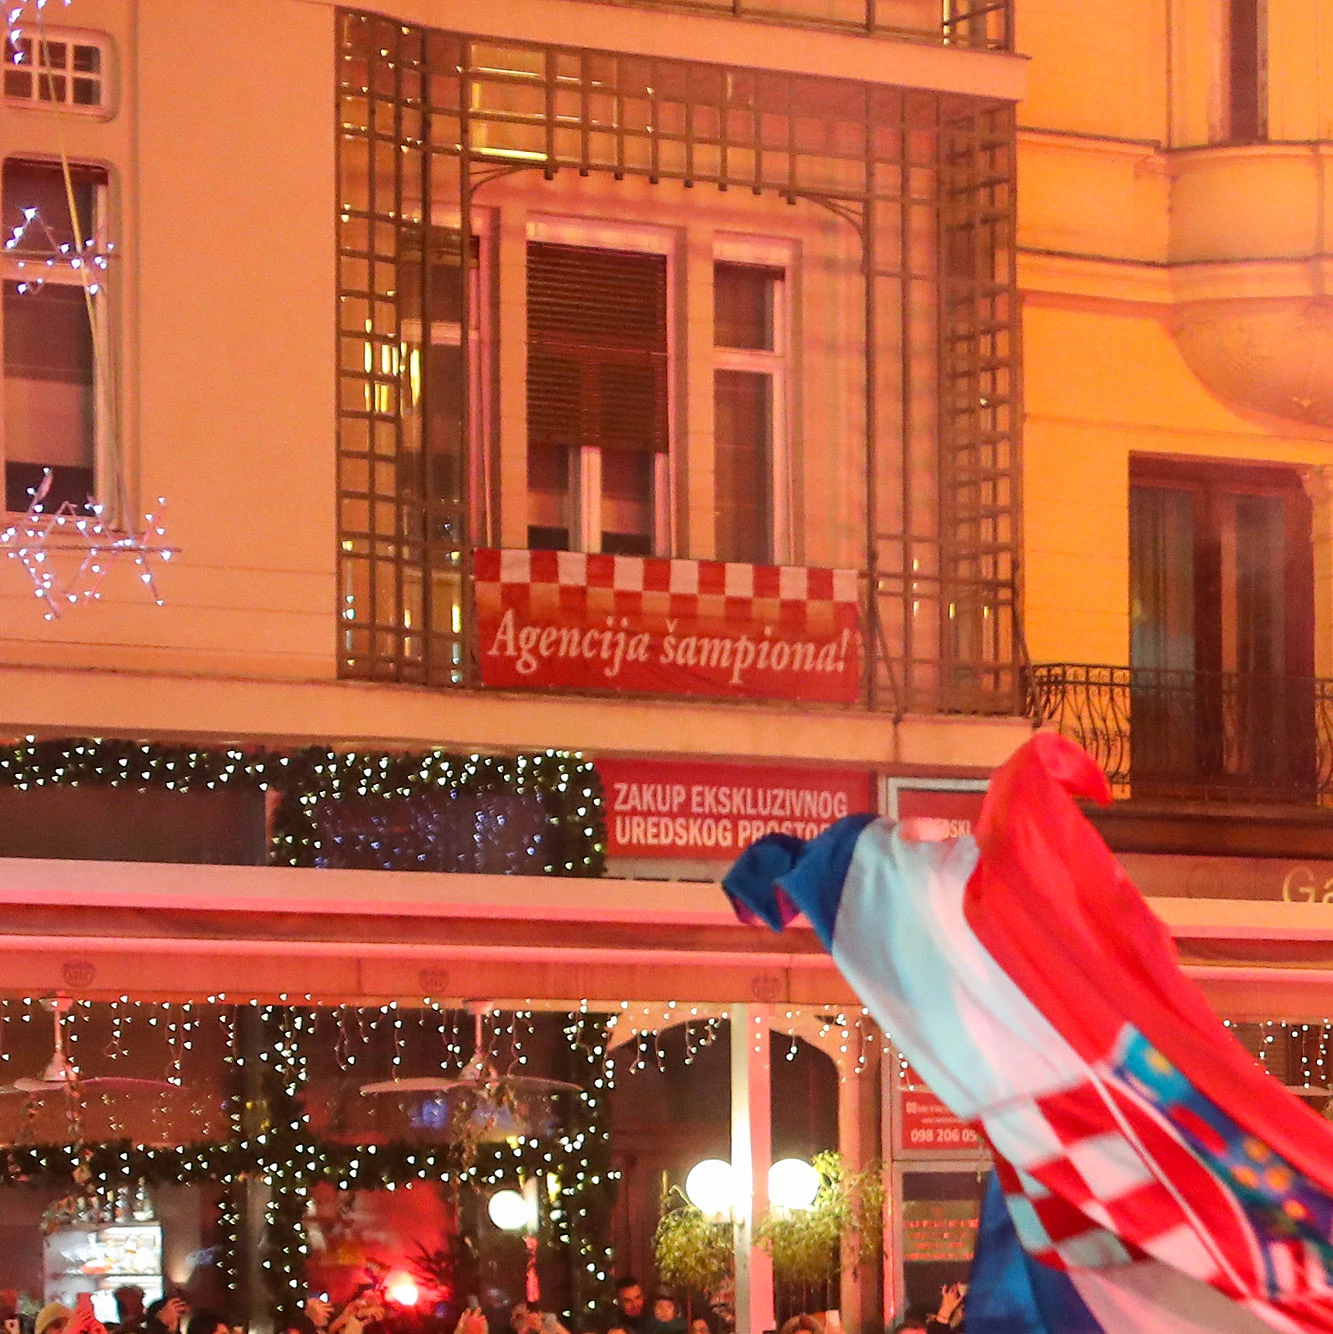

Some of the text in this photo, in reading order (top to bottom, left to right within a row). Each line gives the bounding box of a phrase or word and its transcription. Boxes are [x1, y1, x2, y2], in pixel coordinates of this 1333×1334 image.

[488, 608, 850, 684] Agencija šampiona!
[613, 782, 849, 819] ZAKUP EKSKLUZIVNOG
[615, 815, 733, 848] UREDSKOG
